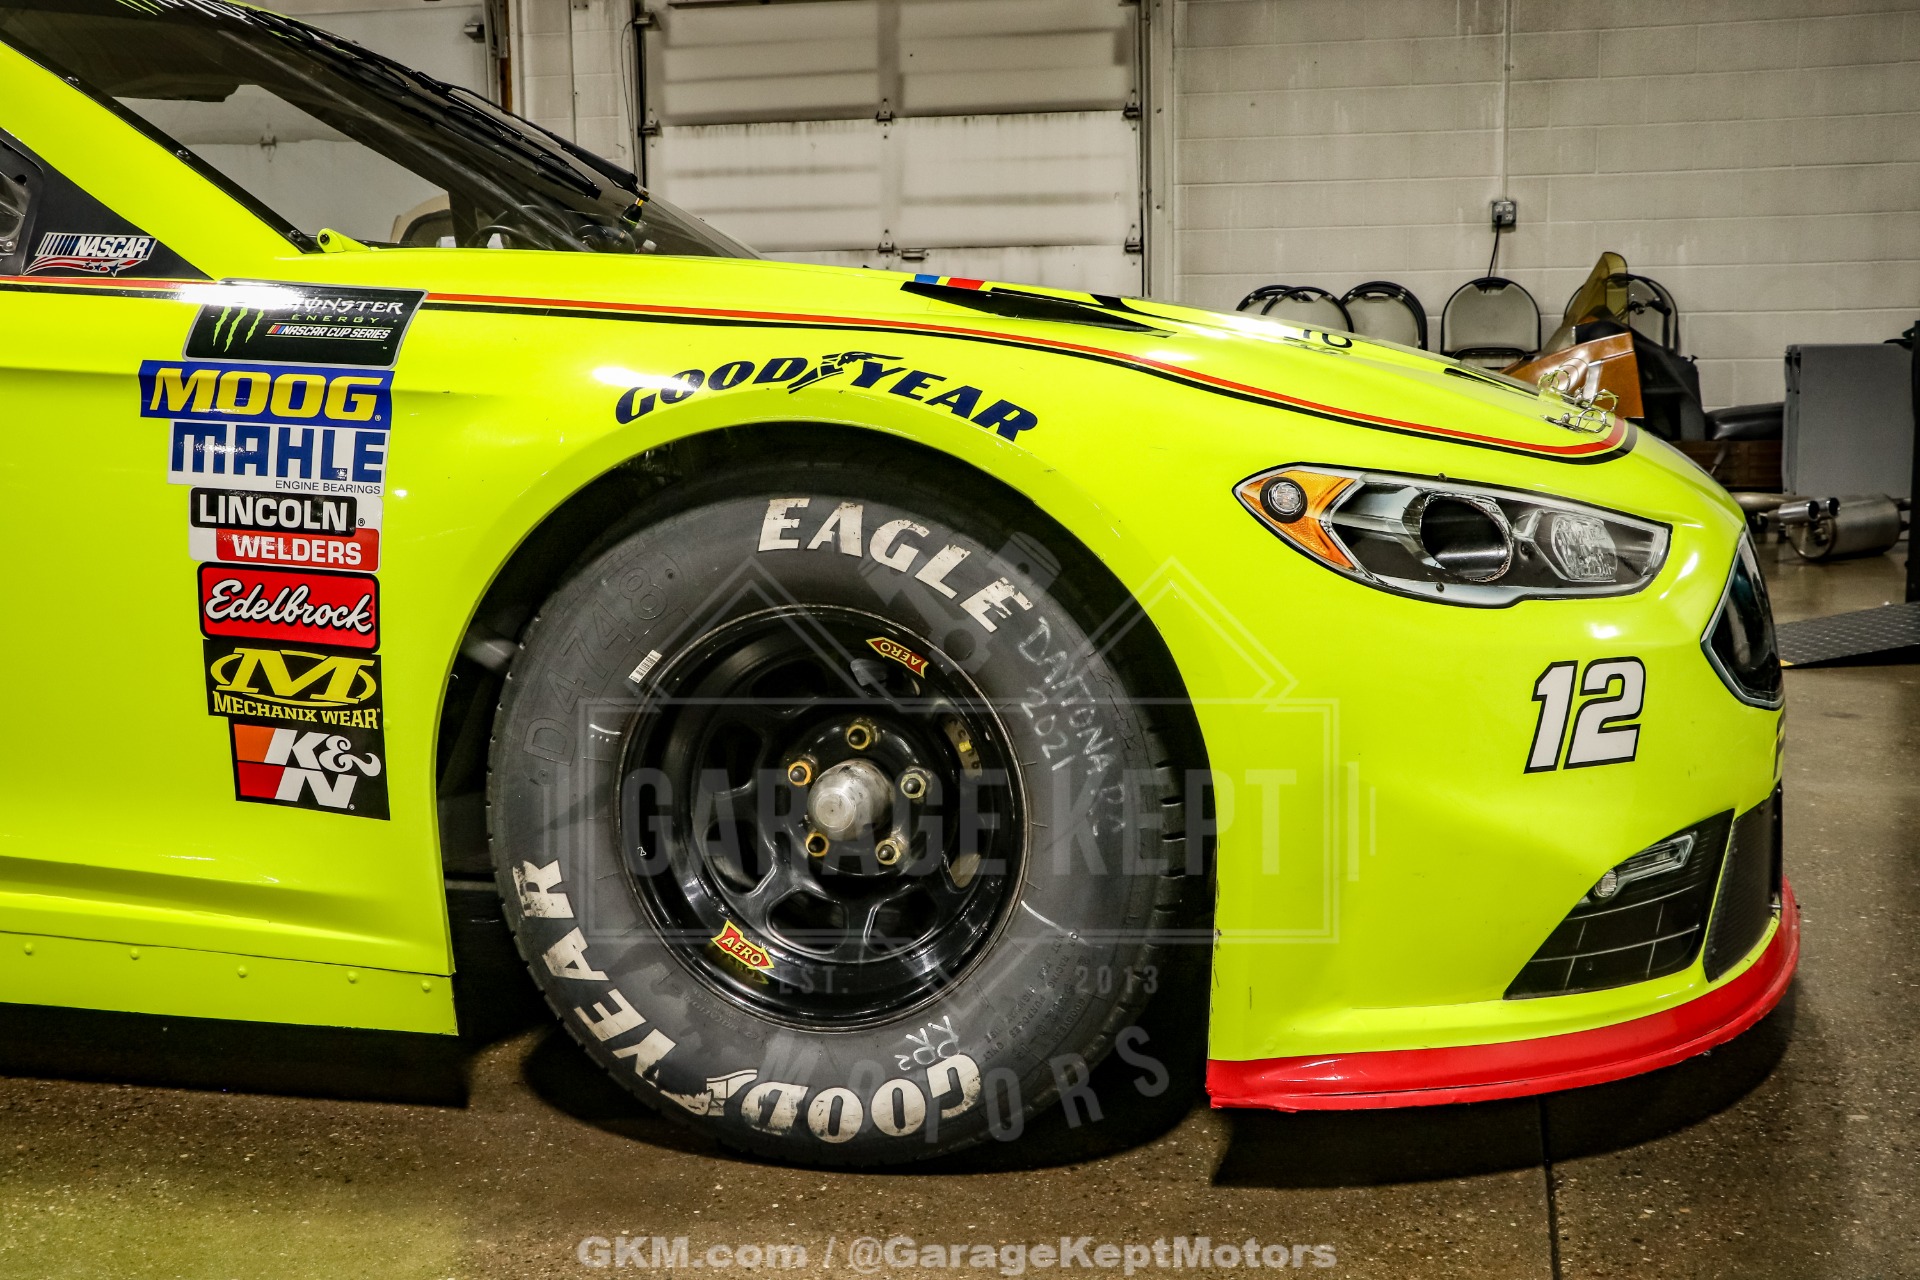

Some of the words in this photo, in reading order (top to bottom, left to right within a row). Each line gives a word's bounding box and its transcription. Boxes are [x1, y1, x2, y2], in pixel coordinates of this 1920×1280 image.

[76, 236, 148, 258] NASCAR
[281, 325, 332, 337] NASCAR
[327, 327, 351, 337] CUP
[351, 328, 391, 339] SERIES
[291, 314, 380, 323] ENERGY
[149, 368, 383, 422] MOOG
[615, 355, 1039, 443] GOODYEAR
[172, 422, 386, 483] MAHLE
[275, 480, 319, 492] ENGINE
[322, 482, 381, 495] BEARINGS
[200, 494, 349, 532] LINCOLN
[232, 533, 362, 566] WELDERS
[757, 498, 1034, 633] EAGLE
[205, 579, 373, 633] Edelbrock
[880, 642, 922, 666] AERO
[213, 691, 318, 723] MECHANIX
[321, 708, 379, 729] WEAR
[1018, 616, 1116, 775] DAYTONA
[1523, 655, 1646, 774] 12
[1020, 687, 1076, 771] 2021
[721, 936, 762, 966] AERO
[1048, 955, 1069, 989] RACING
[1008, 995, 1046, 1039] PURPOSES
